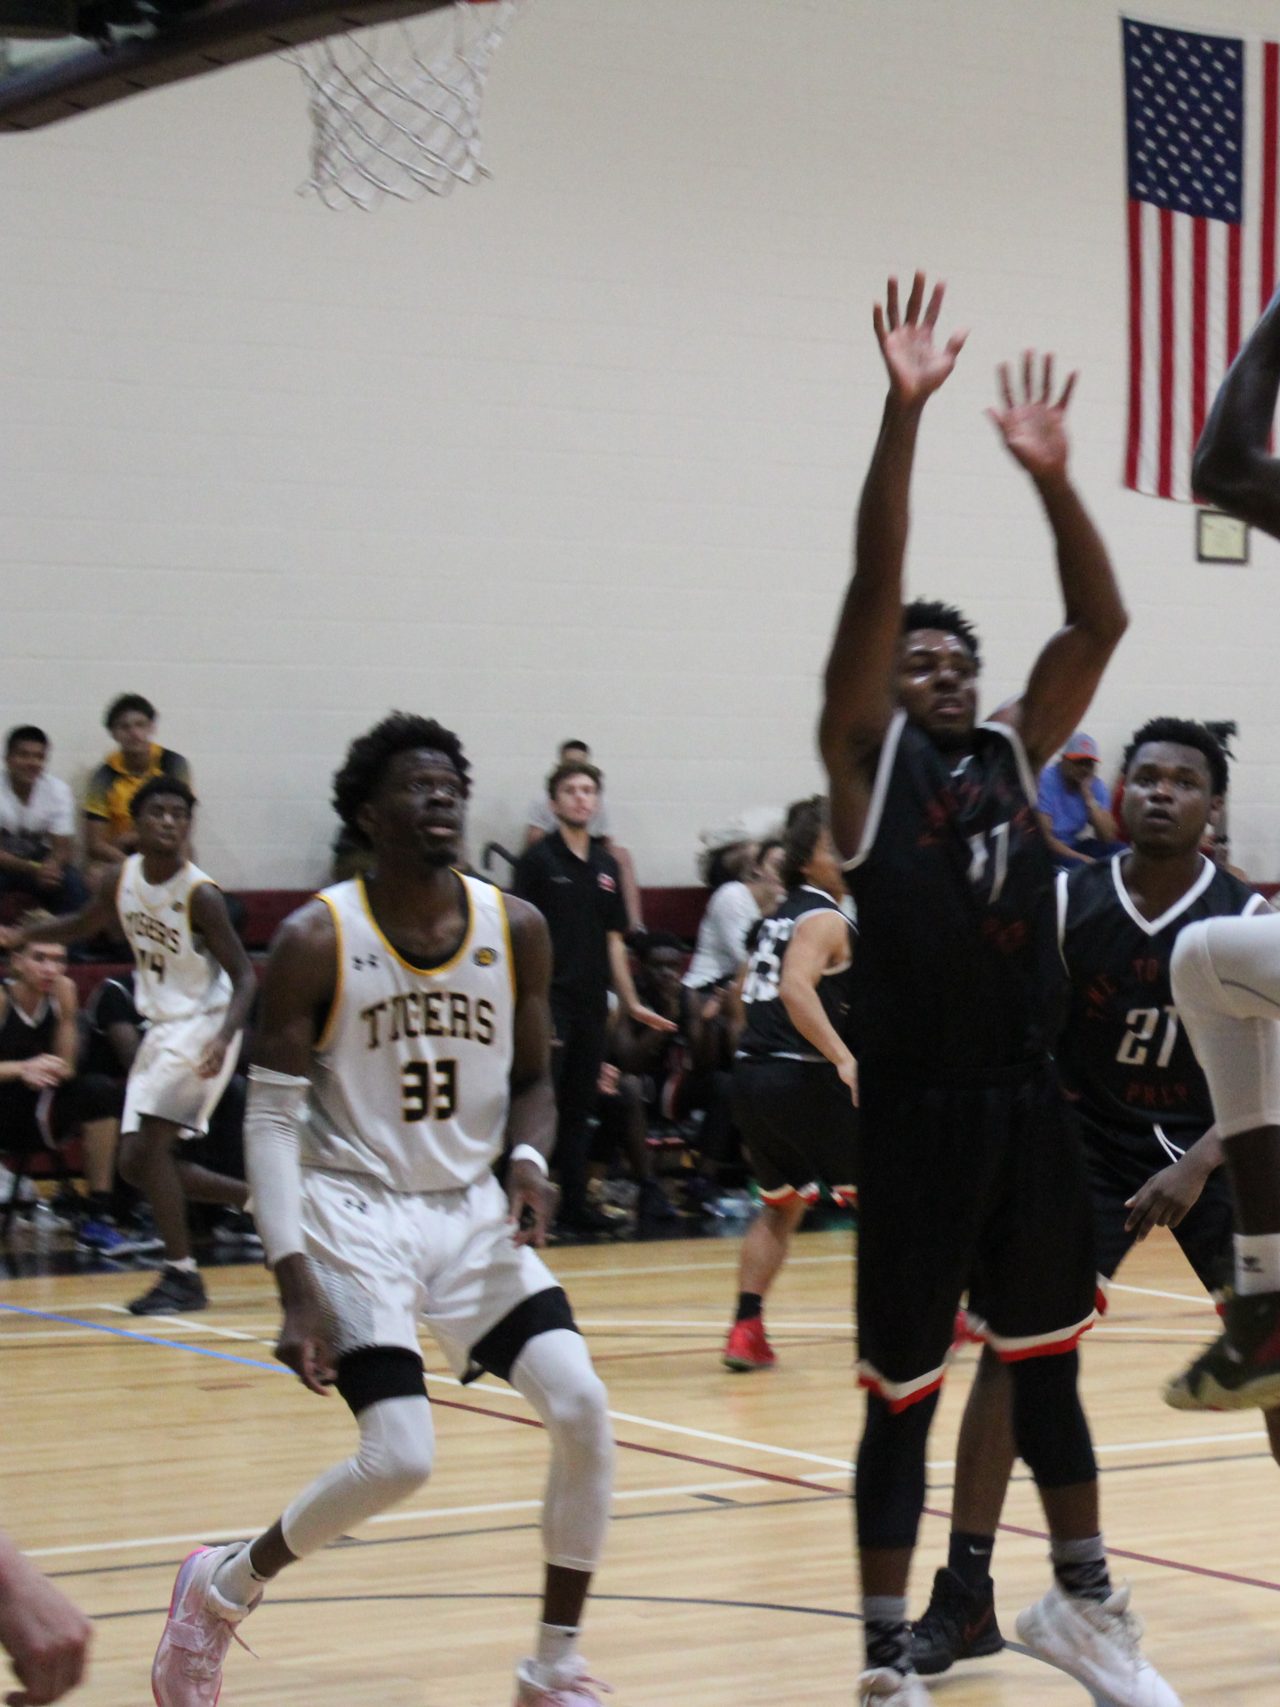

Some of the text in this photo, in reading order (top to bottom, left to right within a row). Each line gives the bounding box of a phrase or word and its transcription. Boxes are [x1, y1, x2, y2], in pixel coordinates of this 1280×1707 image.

[360, 991, 495, 1049] TIGERS
[1115, 1005, 1179, 1069] 21
[402, 1058, 459, 1122] 33
